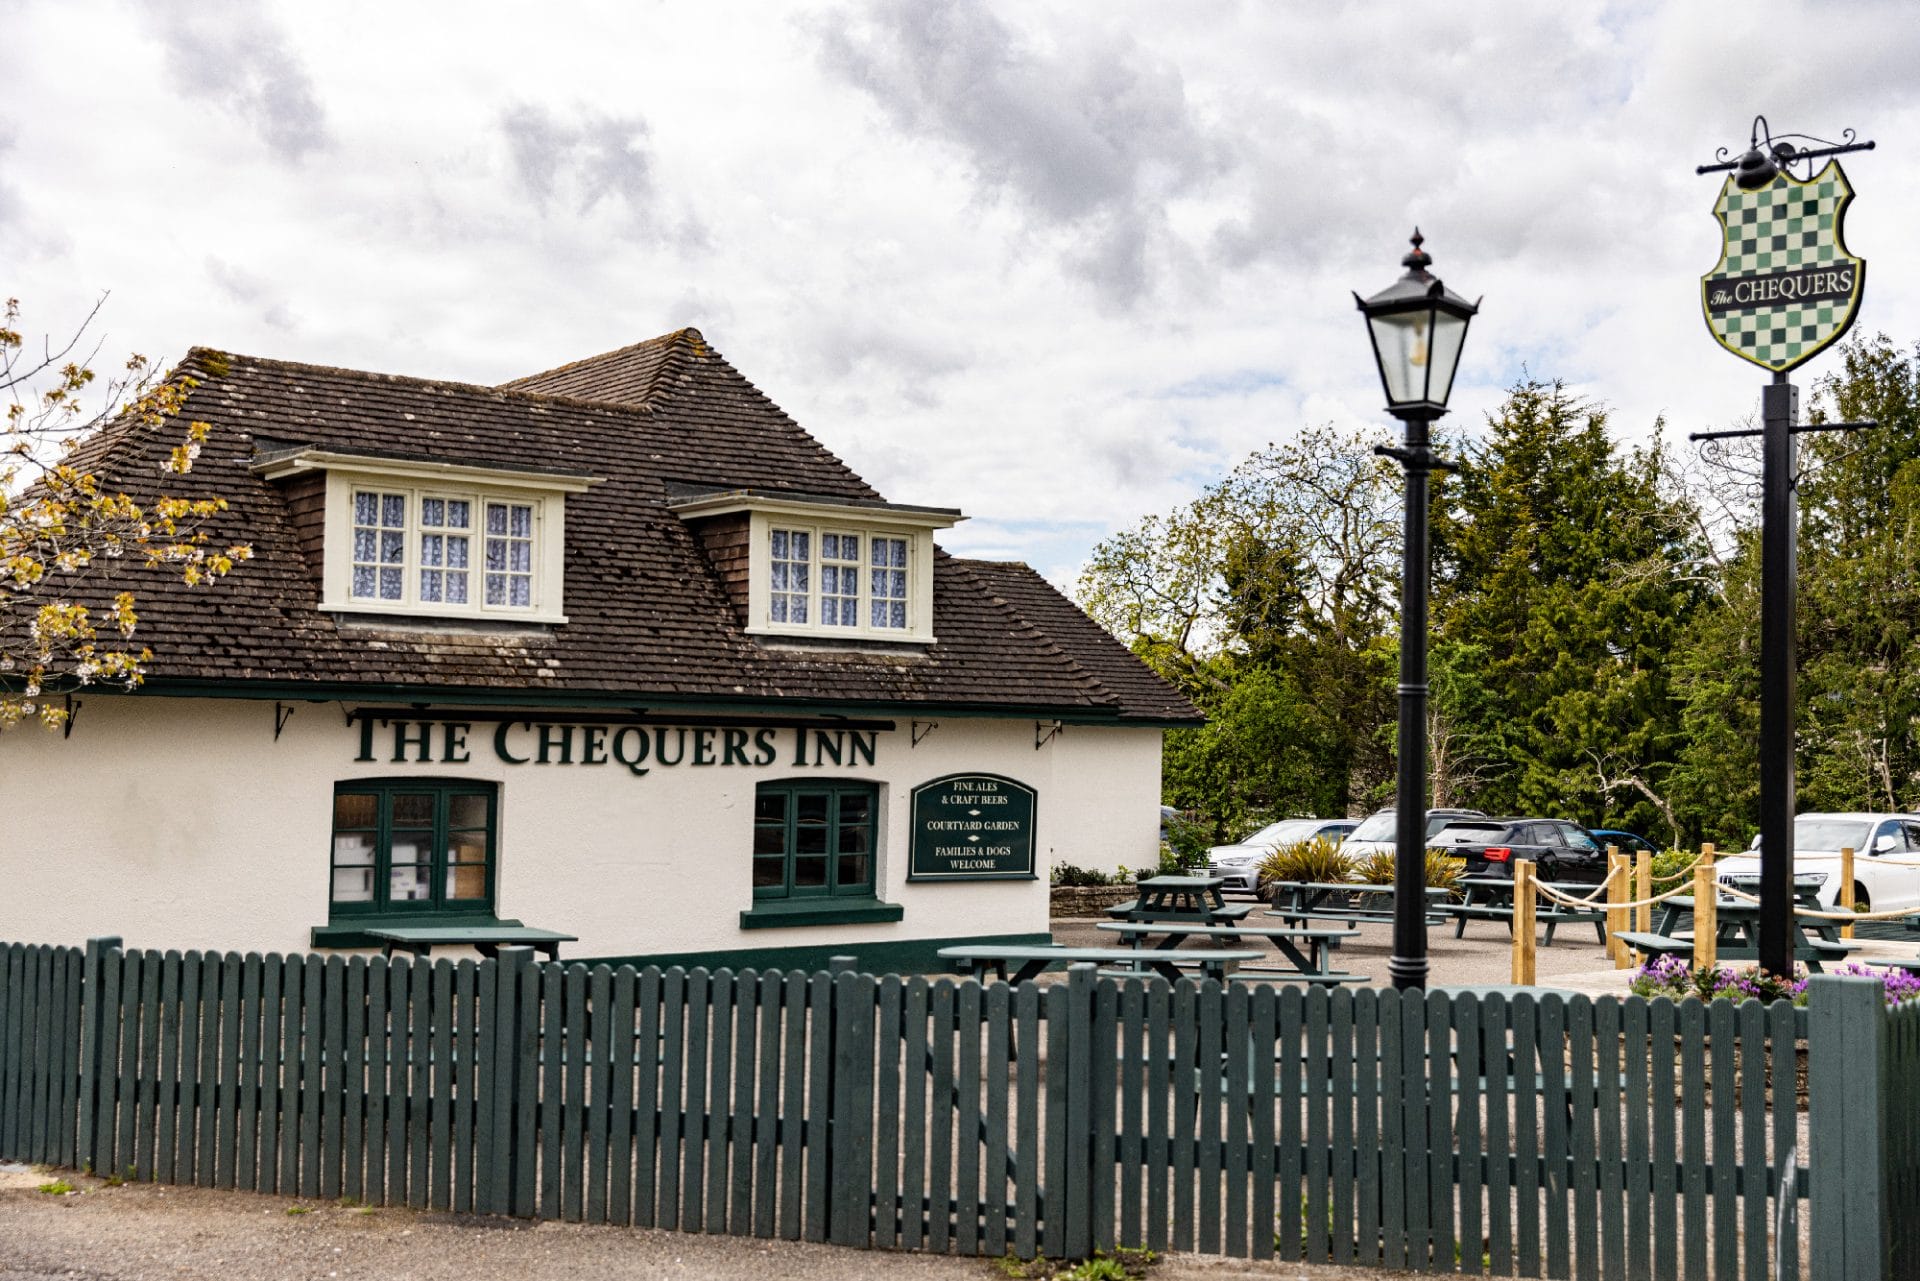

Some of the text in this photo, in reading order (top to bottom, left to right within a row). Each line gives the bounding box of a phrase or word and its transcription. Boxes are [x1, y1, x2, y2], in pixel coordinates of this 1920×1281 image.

[1710, 270, 1852, 306] The CHEQUERS
[346, 717, 879, 776] THE CHEQUERS INN
[953, 782, 998, 791] FINE ALES
[941, 795, 1008, 805] & CRAFT BEERS
[927, 821, 1020, 831] COURTYARD GARDEN
[935, 846, 1011, 856] FAMILIES & DOGS
[950, 860, 996, 869] WELCOME
